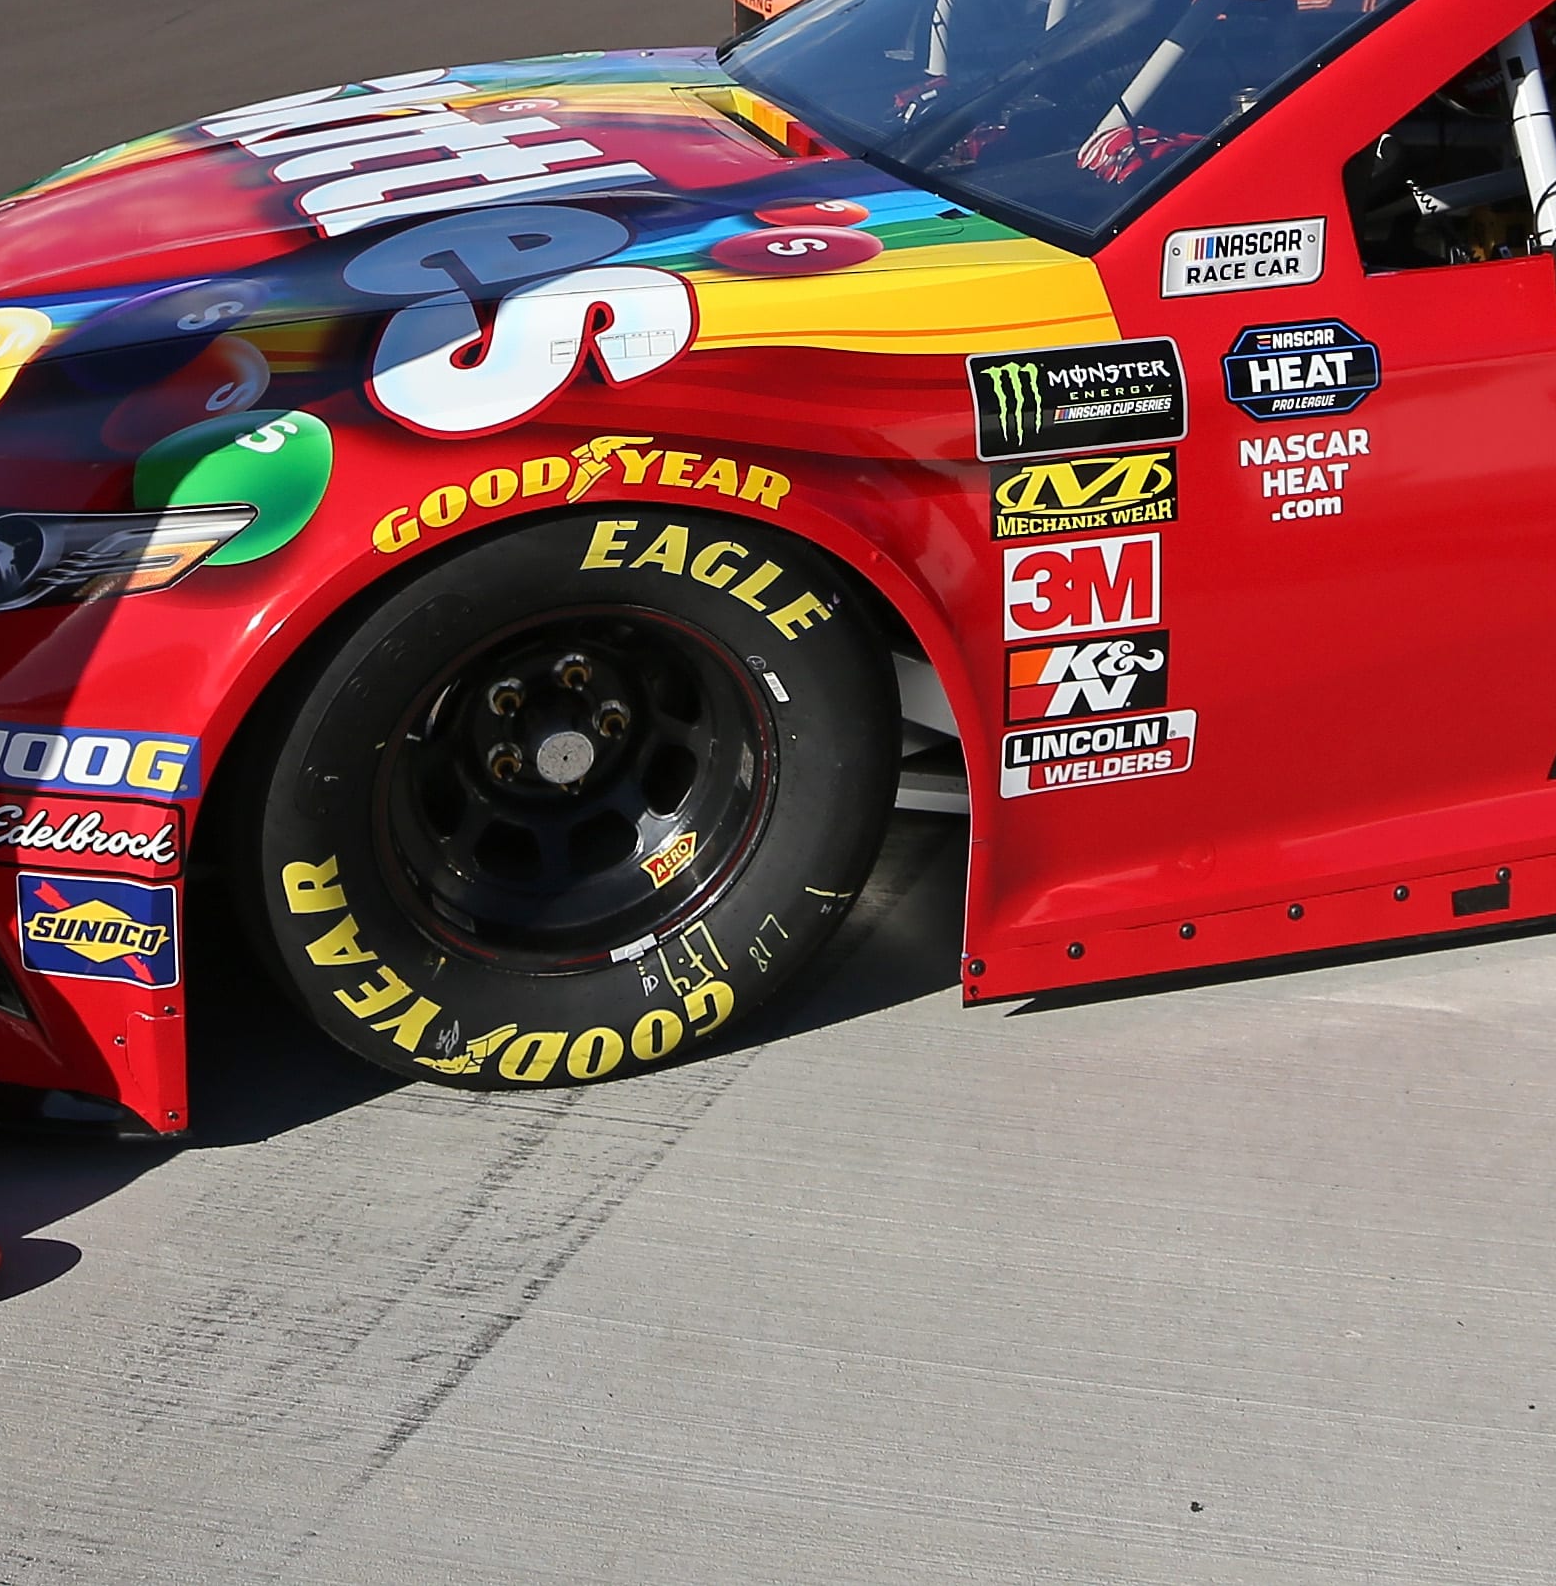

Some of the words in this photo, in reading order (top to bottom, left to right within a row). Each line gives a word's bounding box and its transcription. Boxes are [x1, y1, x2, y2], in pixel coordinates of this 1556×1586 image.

[1214, 228, 1303, 259] NASCAR
[1186, 262, 1246, 285] RACE
[1253, 257, 1300, 278] CAR
[1271, 328, 1335, 348] NASCAR
[1047, 359, 1171, 390] MONSTER
[1247, 351, 1354, 393] HEAT
[1067, 402, 1113, 421] NASCAR
[1112, 400, 1135, 417] CUP
[1134, 396, 1172, 414] SERIES
[1069, 383, 1156, 401] ENERGY
[1271, 398, 1294, 412] PRO
[1294, 394, 1336, 410] LEAGUE
[1239, 428, 1371, 468] NASCAR
[1262, 463, 1350, 498] HEAT
[996, 512, 1108, 538] MECHANIX
[1111, 500, 1173, 525] WEAR
[1270, 496, 1342, 522] .com
[579, 518, 832, 641] EAGLE
[1009, 539, 1154, 632] 3M
[1012, 721, 1161, 765] LINCOLN
[1043, 748, 1173, 786] WELDERS
[654, 840, 690, 877] AERO
[35, 916, 162, 953] SUNOCO
